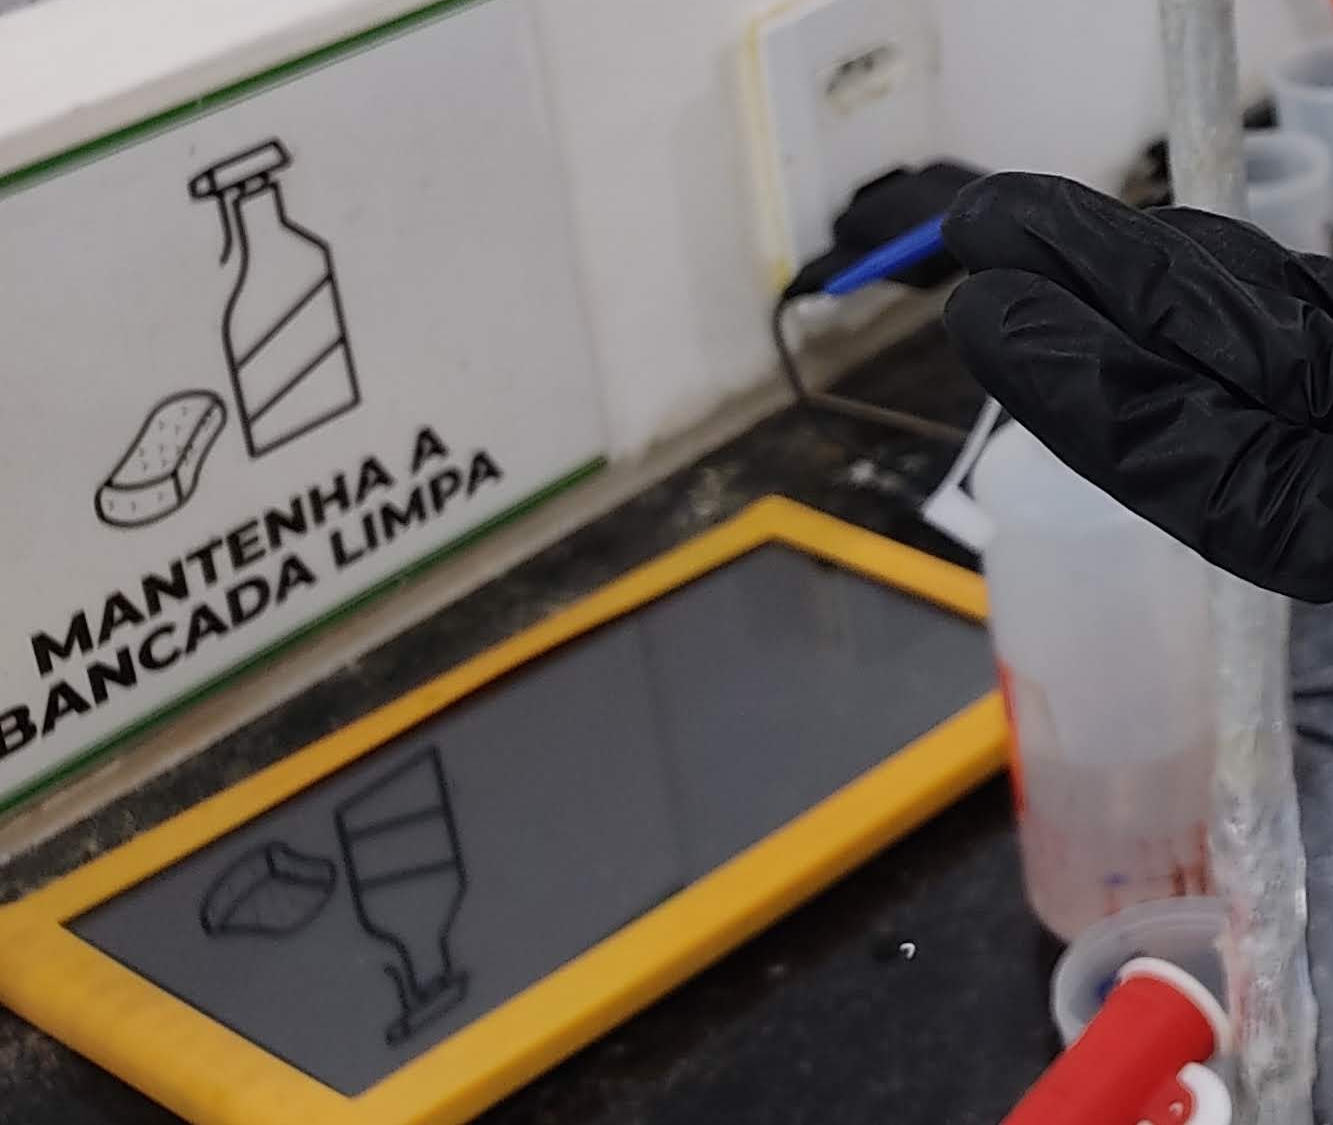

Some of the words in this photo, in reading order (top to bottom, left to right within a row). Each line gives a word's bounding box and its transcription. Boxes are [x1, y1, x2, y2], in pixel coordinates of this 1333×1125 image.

[0, 556, 318, 760] BANCADA
[330, 451, 504, 570] LIMPA
[31, 456, 395, 677] MANTENHA
[410, 426, 448, 473] A
